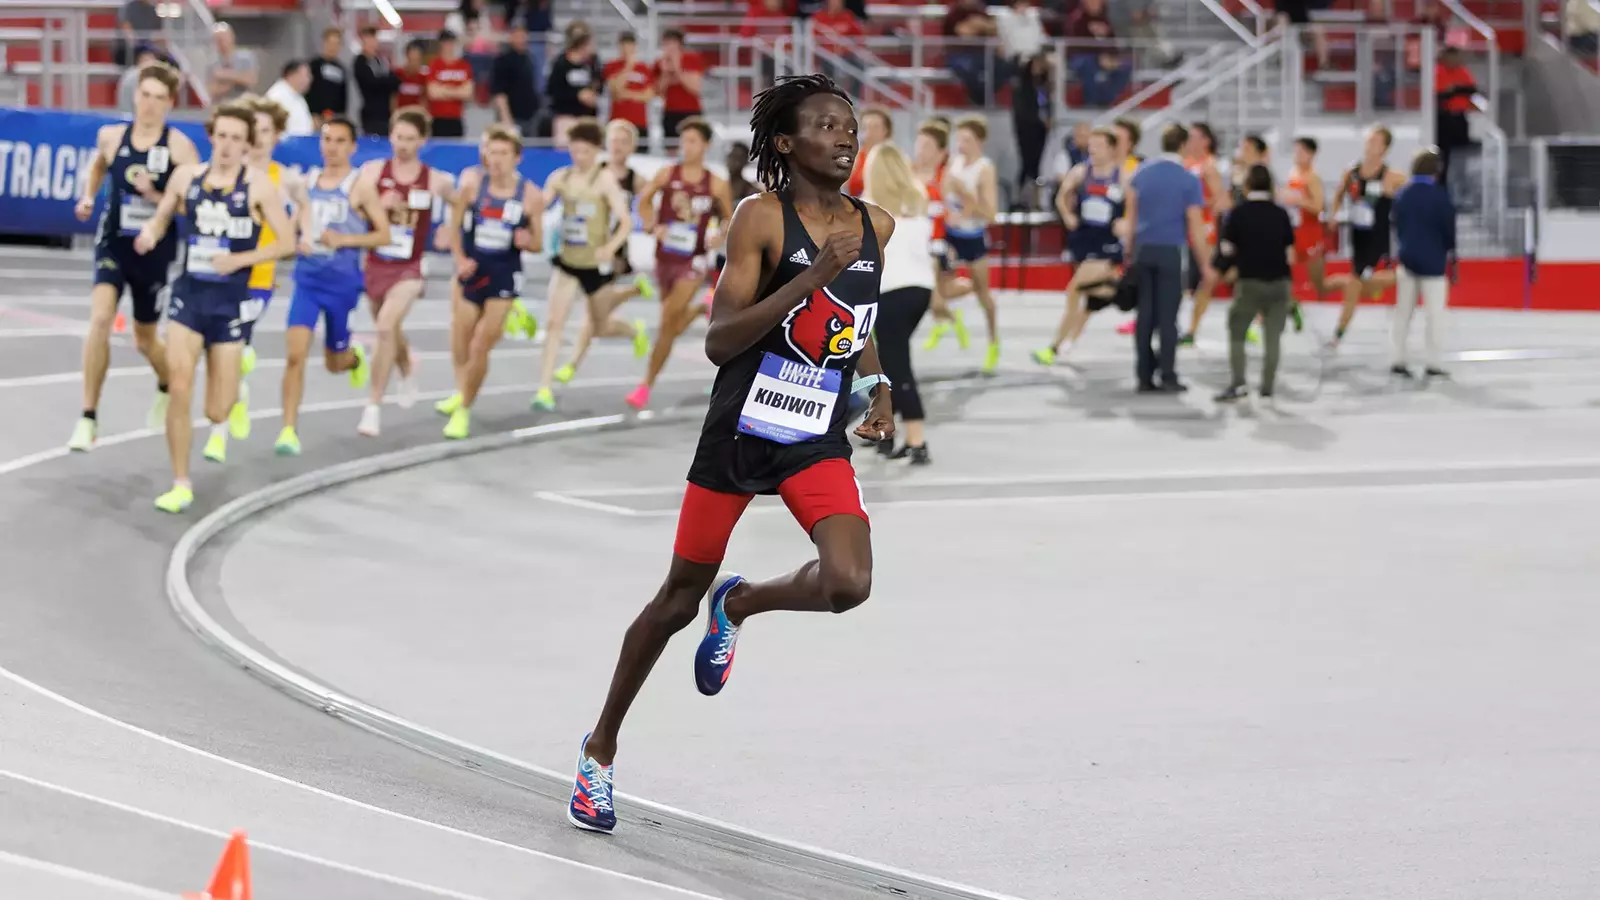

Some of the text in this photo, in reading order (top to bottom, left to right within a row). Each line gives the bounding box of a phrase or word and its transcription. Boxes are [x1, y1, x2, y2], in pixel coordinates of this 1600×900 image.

[789, 256, 812, 266] adidas
[848, 260, 875, 271] ACC
[857, 306, 873, 346] 4
[778, 360, 826, 389] UNITE
[754, 387, 827, 420] KIBIWOT
